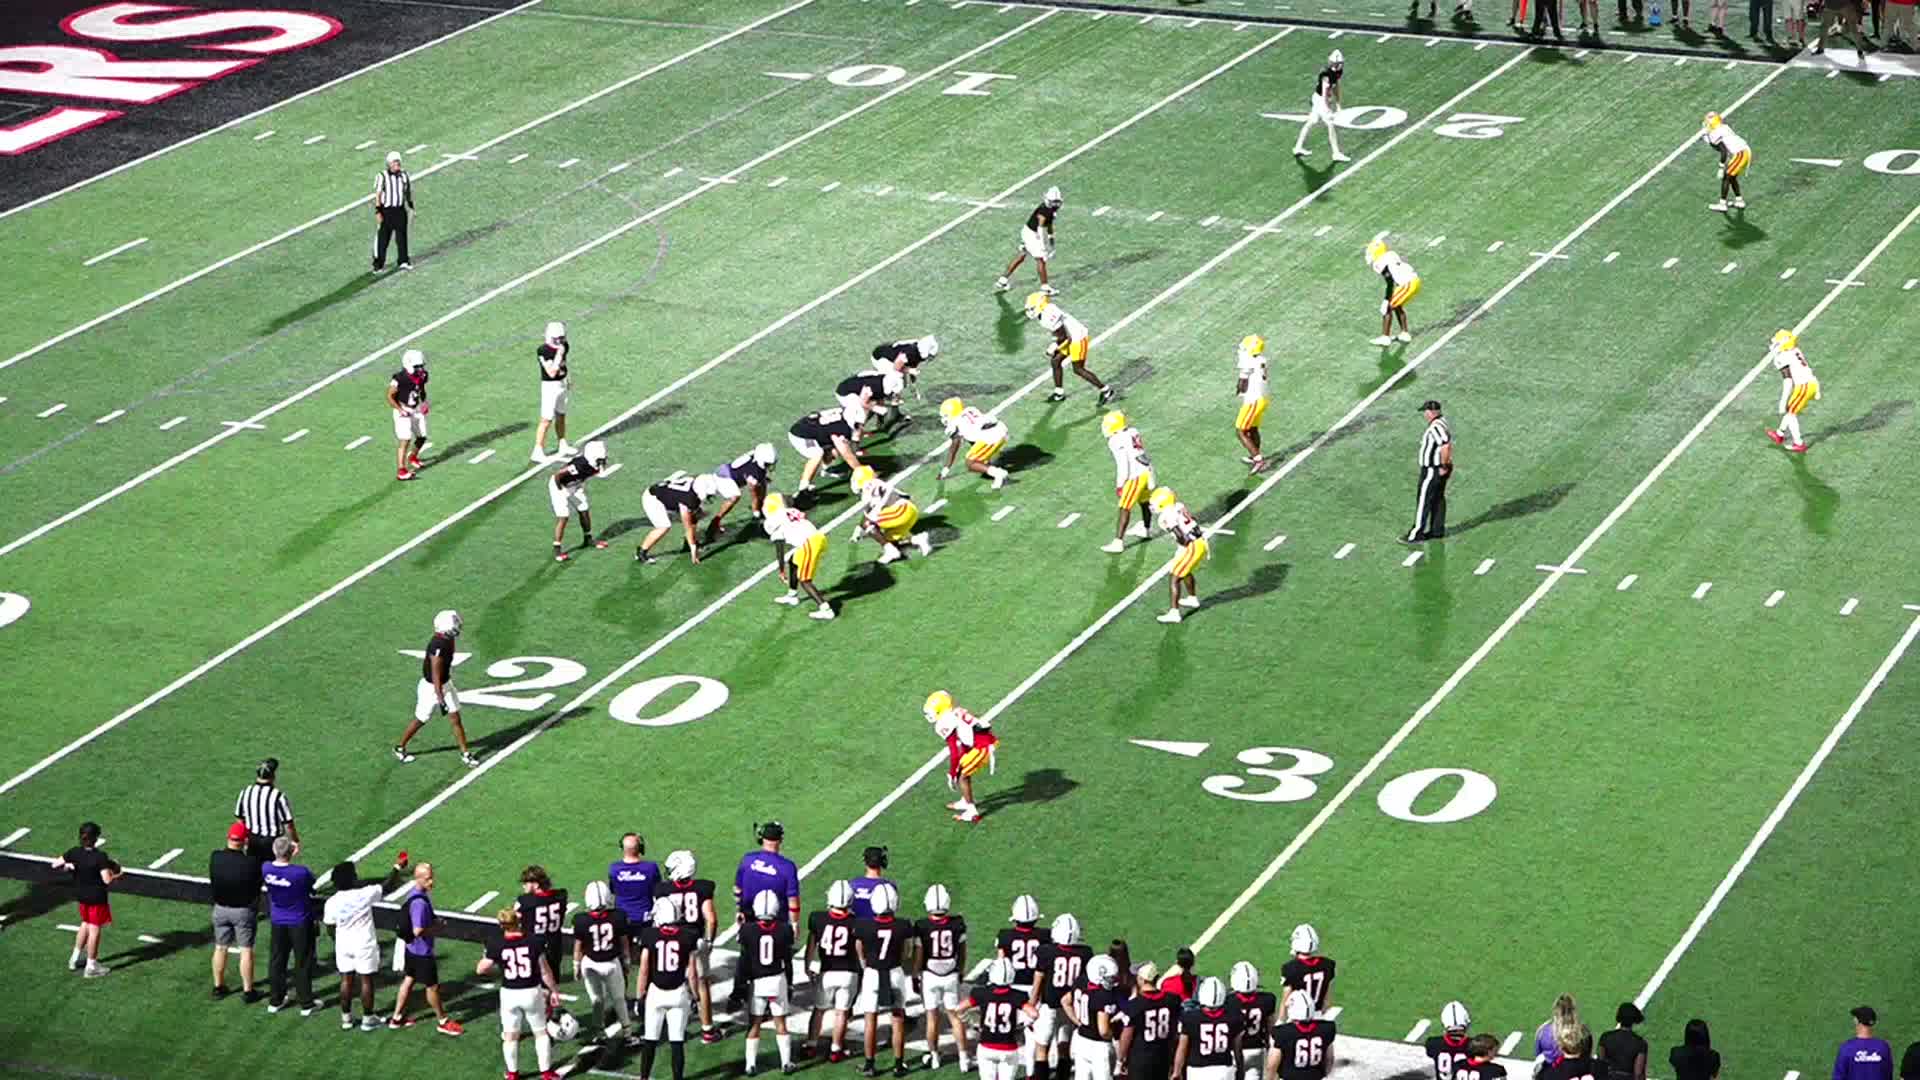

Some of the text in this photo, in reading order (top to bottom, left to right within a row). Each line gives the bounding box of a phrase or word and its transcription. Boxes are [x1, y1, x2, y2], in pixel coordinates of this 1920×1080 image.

[534, 902, 561, 934] 55
[588, 923, 614, 953] 12
[759, 934, 774, 965] 0
[820, 924, 849, 956] 42
[877, 929, 892, 960] 7
[931, 930, 954, 958] 19
[501, 947, 532, 980] 35
[655, 940, 680, 972] 16
[1053, 956, 1082, 988] 80
[1303, 971, 1325, 1003] 17
[984, 1002, 1012, 1034] 43
[1144, 1007, 1170, 1042] 58
[1199, 1023, 1228, 1055] 56
[1295, 1036, 1323, 1067] 66
